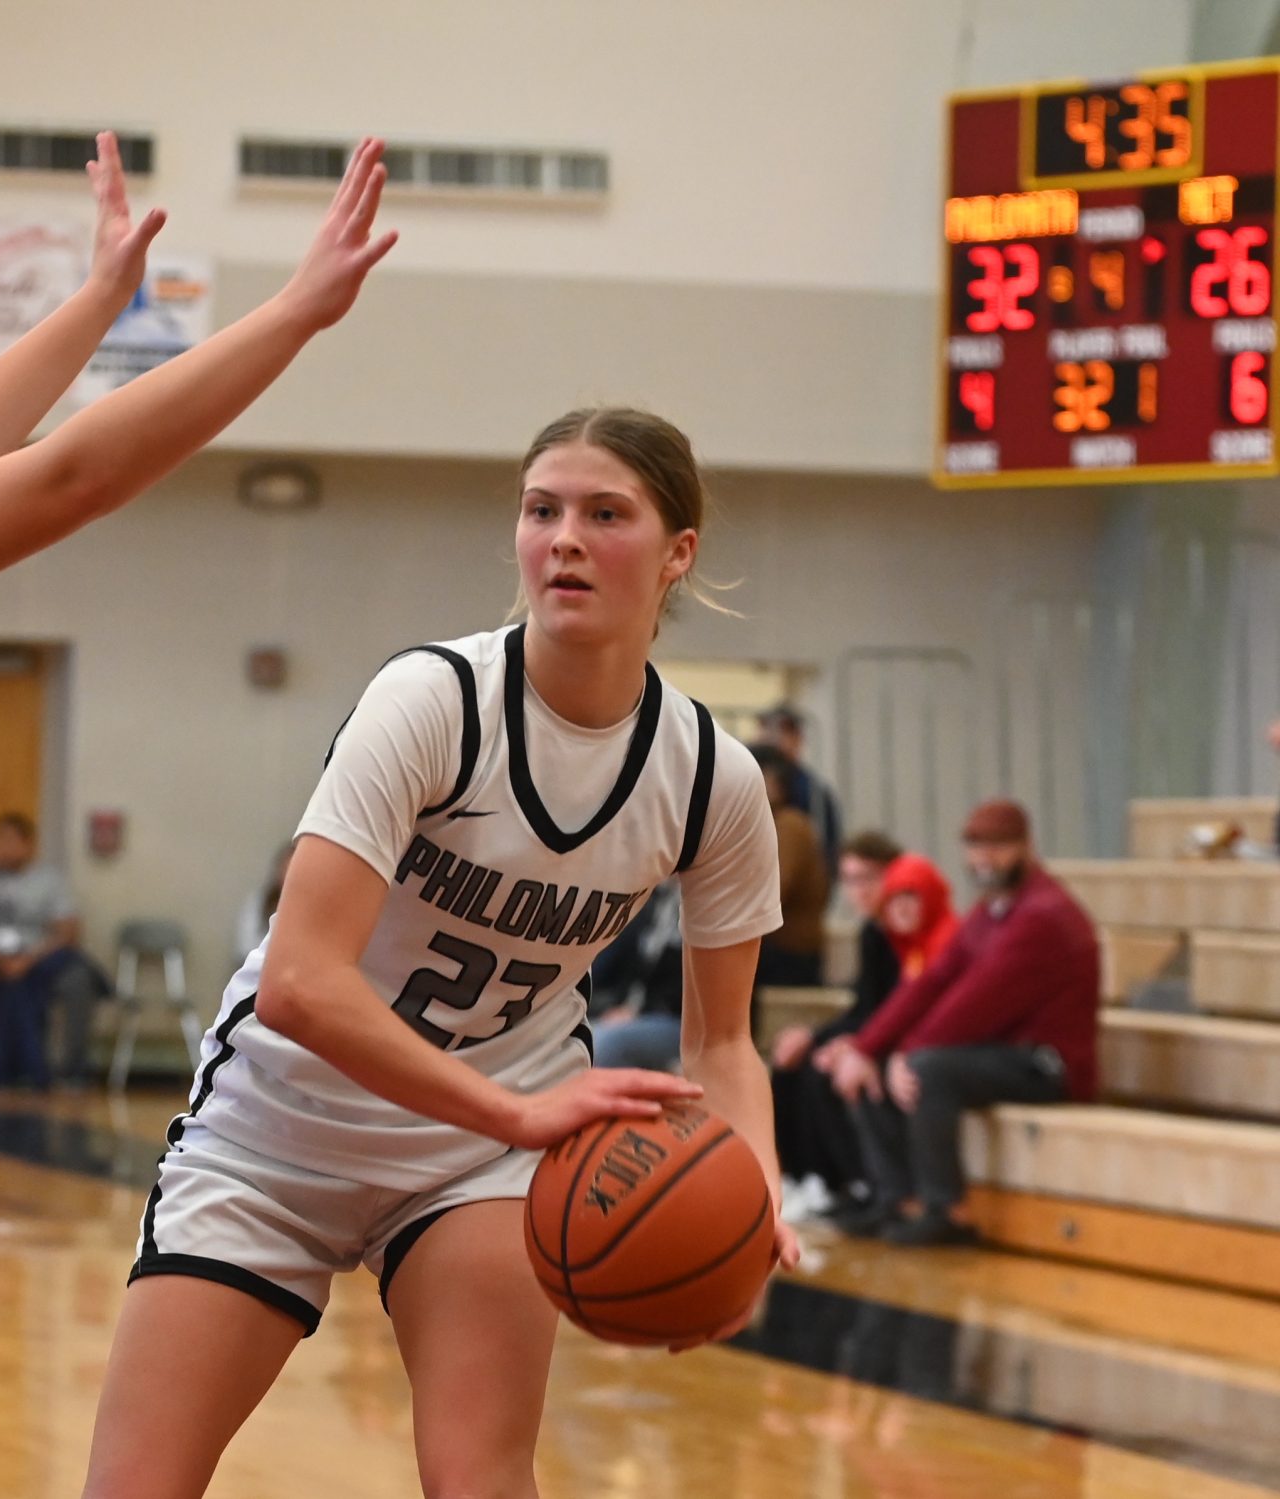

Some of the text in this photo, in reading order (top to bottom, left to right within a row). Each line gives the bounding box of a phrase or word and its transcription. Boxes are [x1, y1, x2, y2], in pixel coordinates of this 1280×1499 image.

[967, 244, 1039, 332] 32
[1090, 251, 1124, 309] 4
[1191, 227, 1270, 318] 26
[960, 371, 995, 430] 4
[1053, 360, 1114, 432] 32
[1231, 351, 1267, 424] 6
[394, 833, 649, 946] PHILOMATH
[391, 930, 561, 1051] 23
